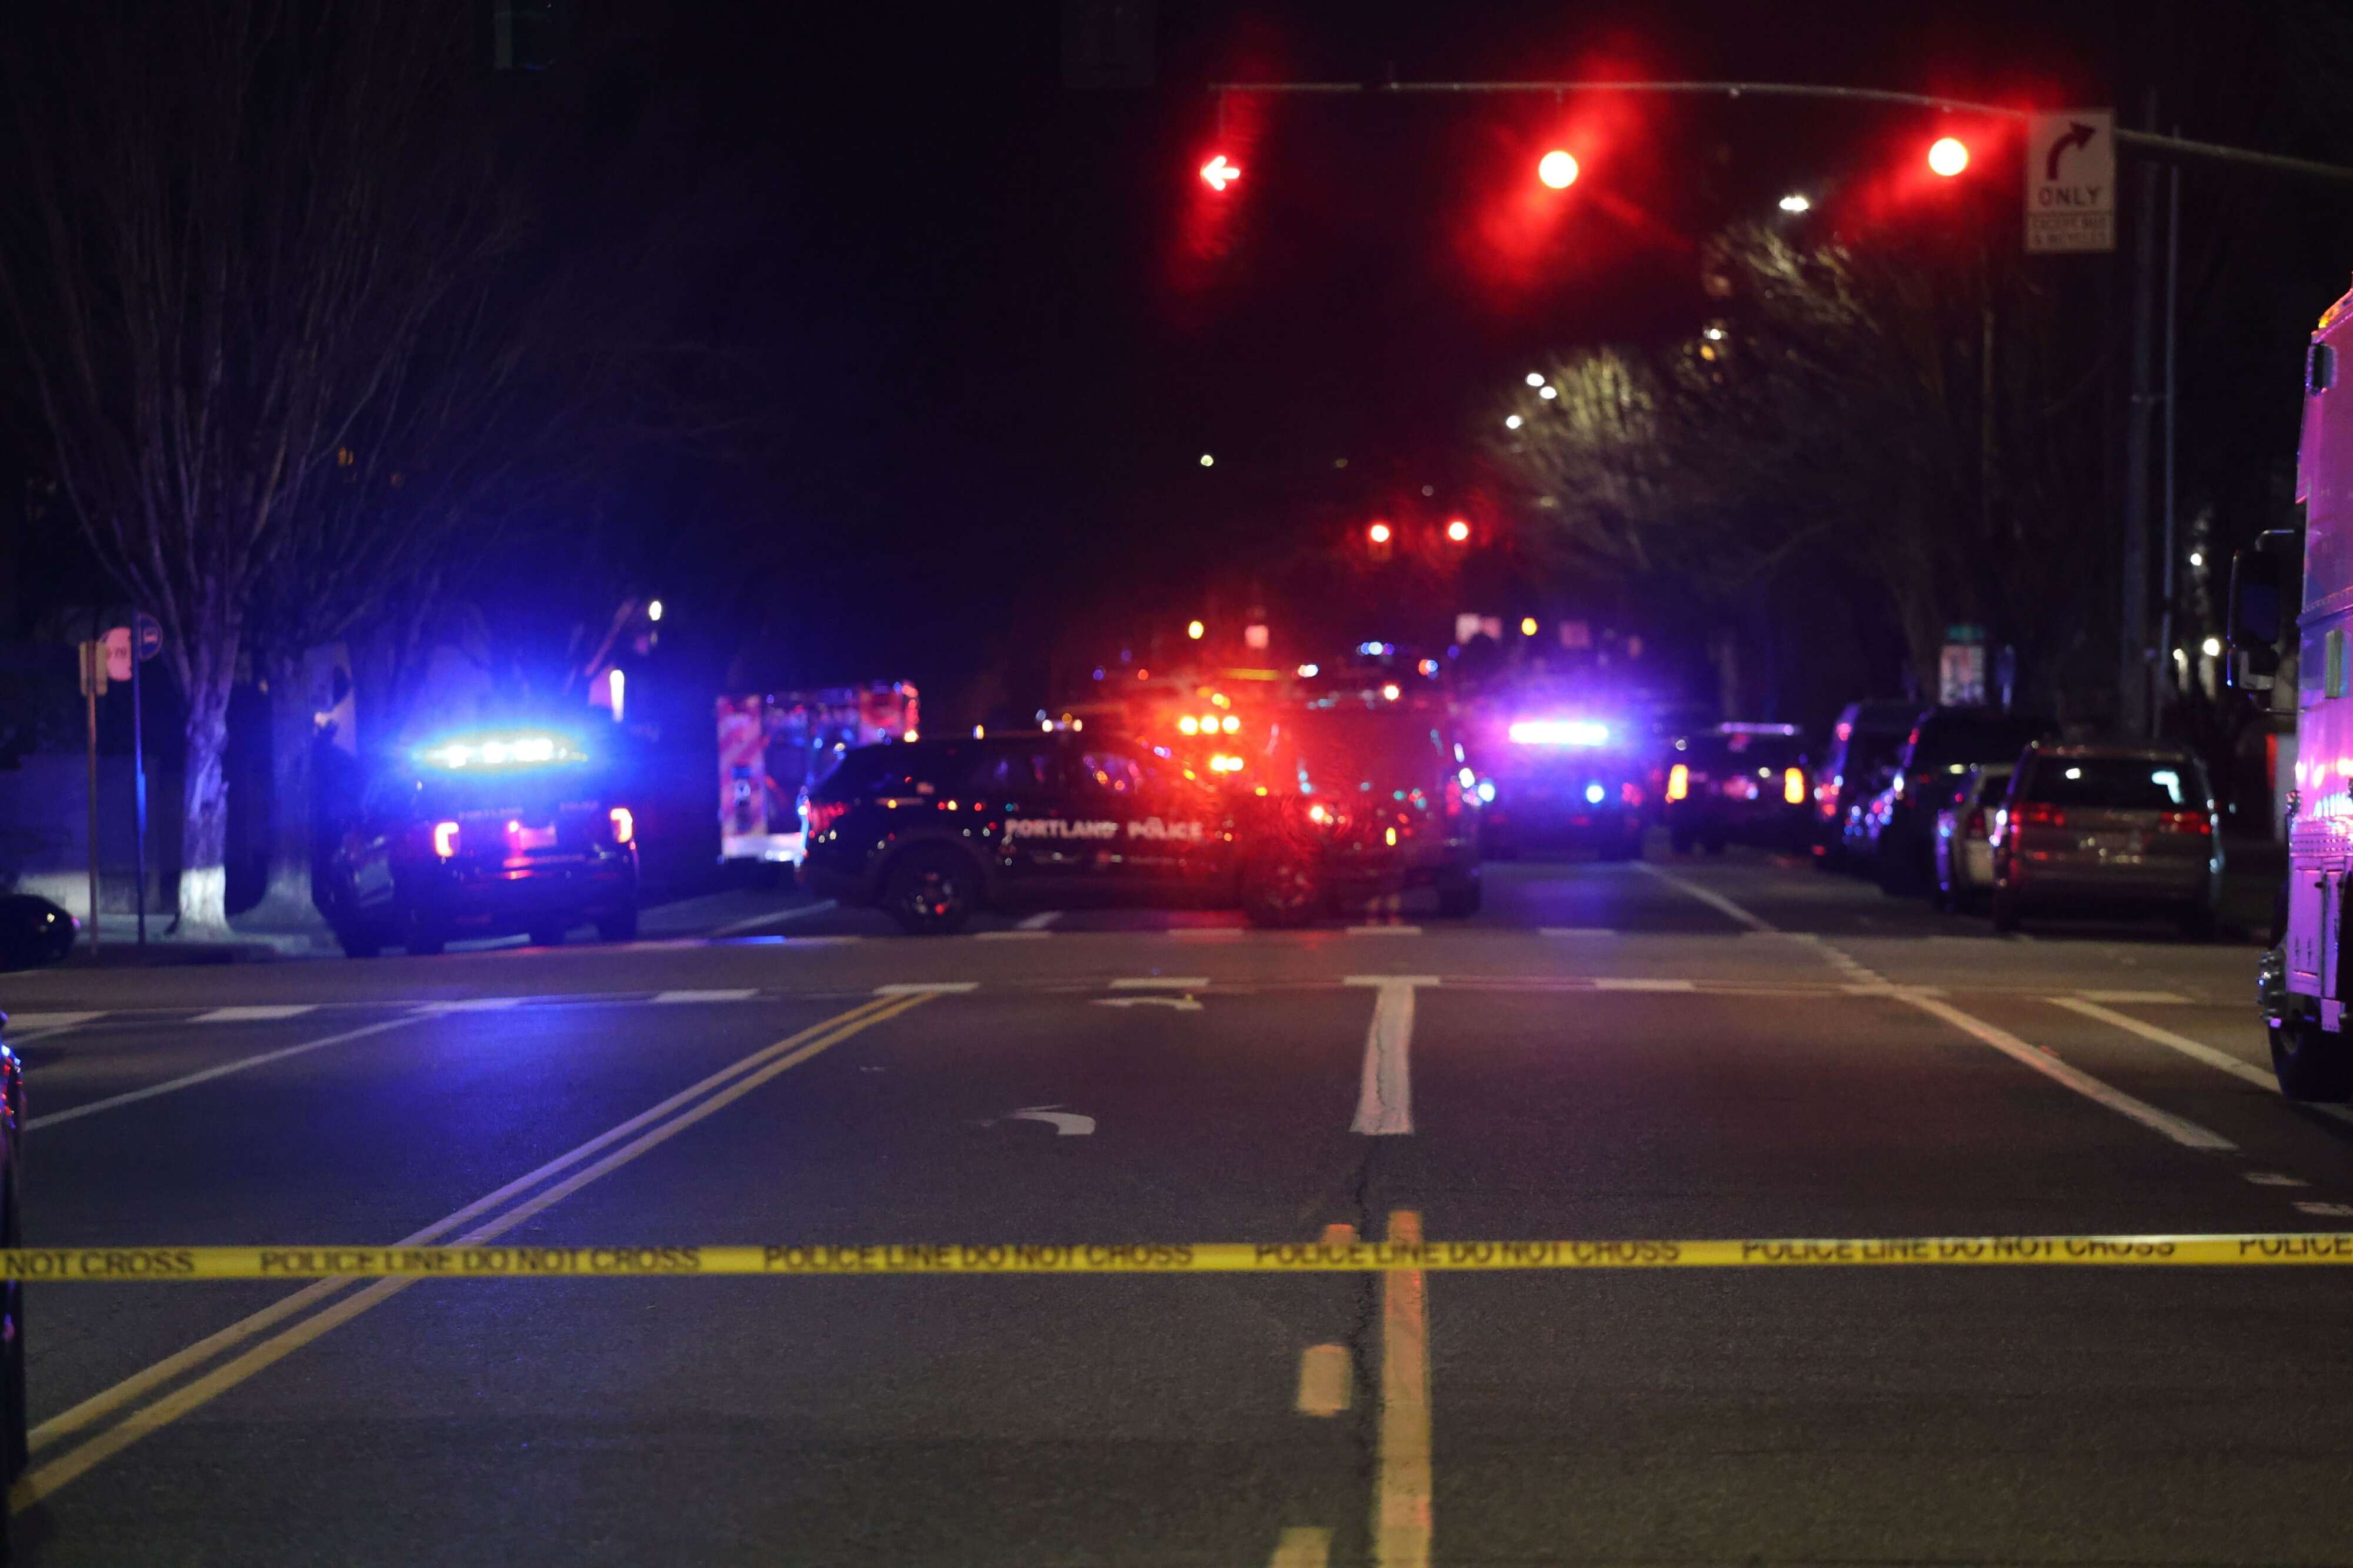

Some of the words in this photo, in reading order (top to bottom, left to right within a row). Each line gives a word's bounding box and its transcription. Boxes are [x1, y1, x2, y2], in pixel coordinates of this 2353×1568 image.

[2038, 186, 2101, 206] ONLY
[1004, 819, 1117, 839] PORTLAND
[1126, 818, 1204, 840] POLICE
[766, 1246, 882, 1269] POLICE
[886, 1246, 954, 1267] LINE
[961, 1245, 1002, 1265] DO
[1016, 1245, 1075, 1266] NOT
[1085, 1244, 1194, 1265] CROSS
[1256, 1244, 1365, 1263] POLICE
[1374, 1243, 1444, 1263] LINE
[1449, 1242, 1493, 1263] DO
[1503, 1242, 1562, 1262] NOT
[1572, 1241, 1680, 1261] CROSS
[1742, 1241, 1854, 1259] POLICE
[1862, 1240, 1932, 1259] LINE
[1939, 1239, 1984, 1257] DO
[1995, 1239, 2052, 1256] NOT
[2239, 1236, 2353, 1256] POLICE
[5, 1252, 71, 1275] NOT
[79, 1251, 195, 1275] CROSS
[260, 1251, 374, 1273] POLICE
[385, 1250, 454, 1272] LINE
[462, 1249, 509, 1271] DO
[518, 1248, 580, 1271] NOT
[590, 1247, 700, 1269] CROSS
